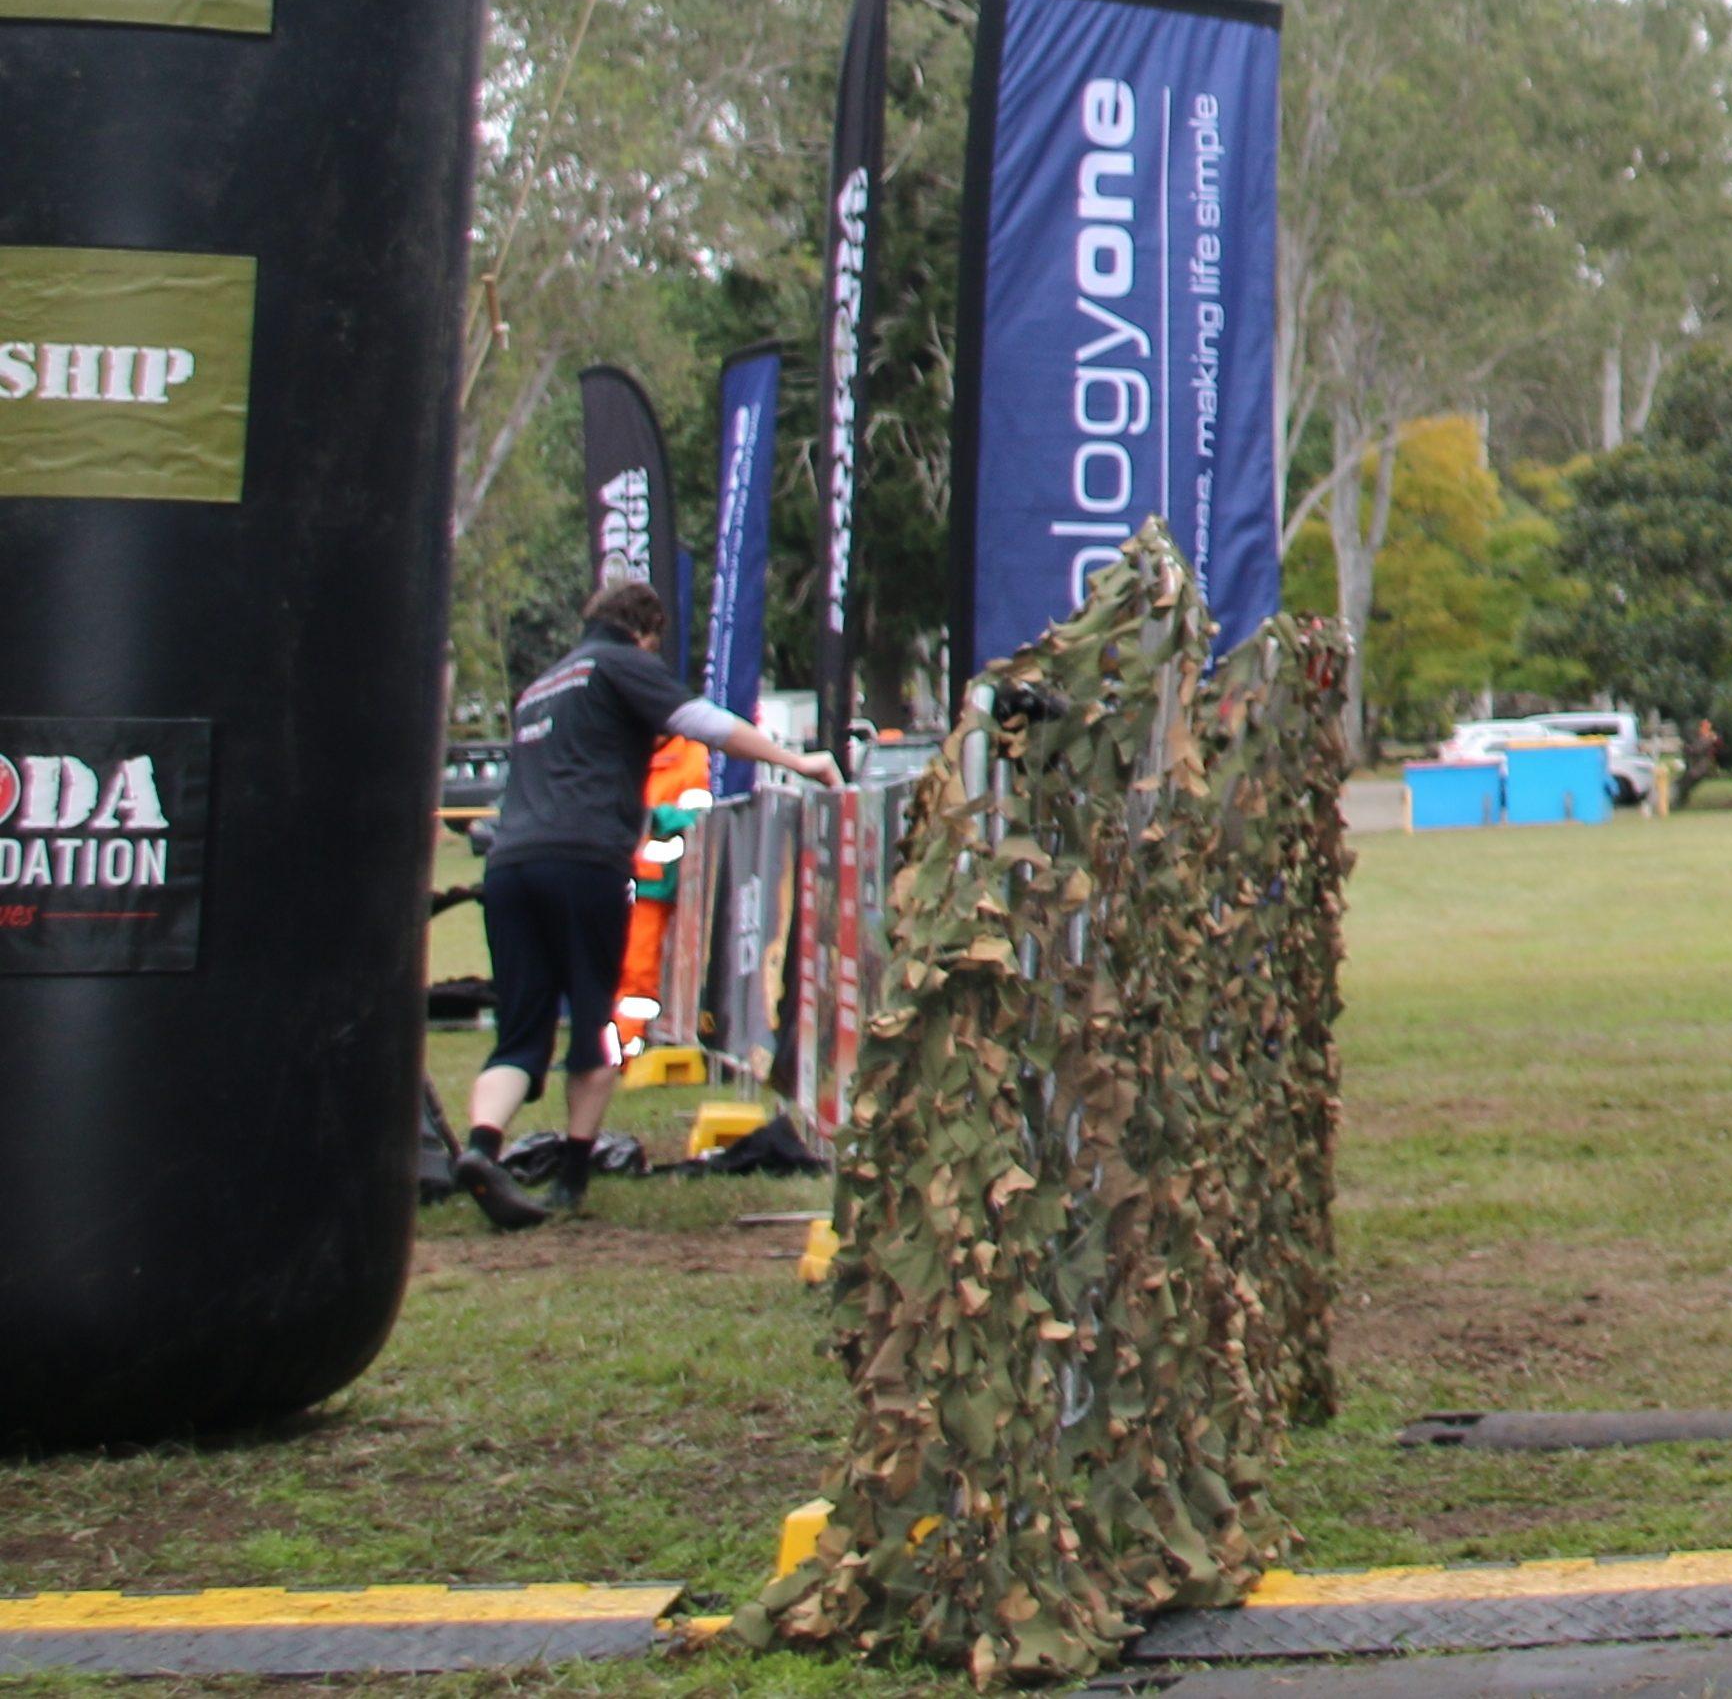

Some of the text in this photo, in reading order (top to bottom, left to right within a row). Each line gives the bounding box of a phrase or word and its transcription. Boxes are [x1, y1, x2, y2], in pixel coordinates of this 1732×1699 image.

[1187, 92, 1224, 229] simple
[1188, 233, 1222, 294] life
[1190, 303, 1226, 457] making
